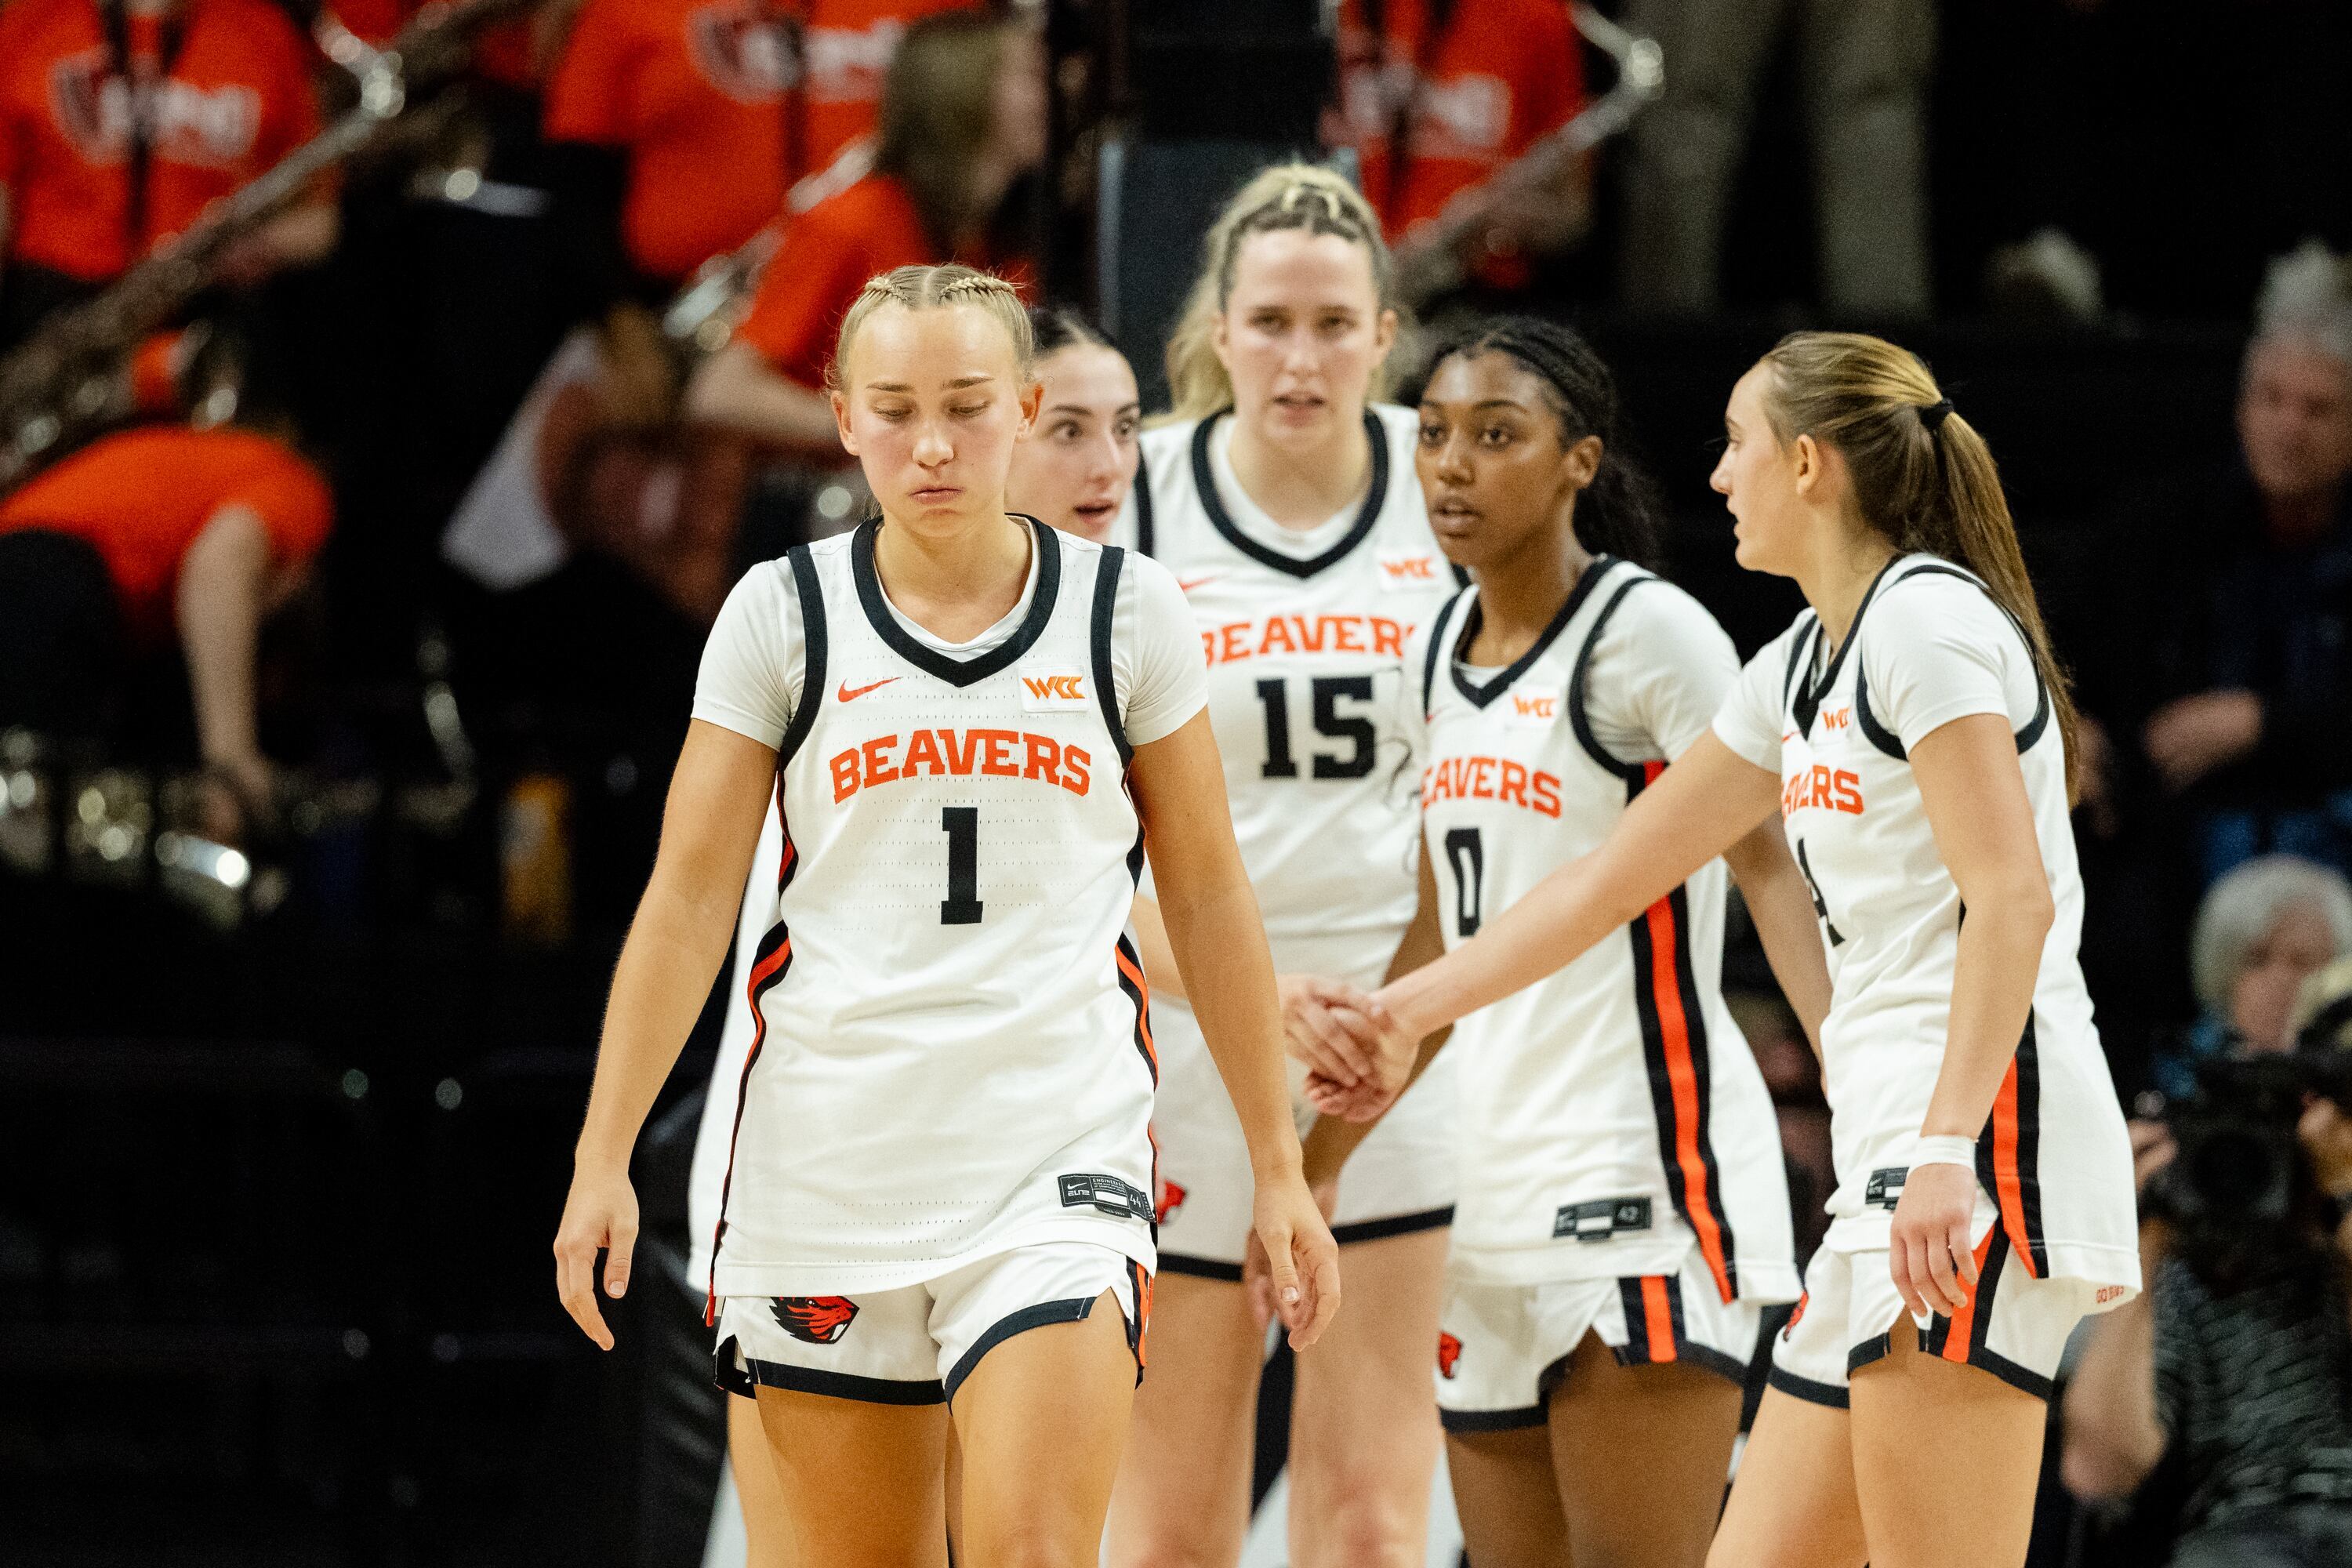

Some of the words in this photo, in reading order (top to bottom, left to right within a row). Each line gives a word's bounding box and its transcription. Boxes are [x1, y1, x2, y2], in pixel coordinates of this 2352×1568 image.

[1381, 556, 1435, 579] WCC
[1201, 615, 1416, 669] BEAVER
[1022, 676, 1085, 699] WCC
[1255, 675, 1375, 779] 15
[829, 728, 1091, 805] BEAVERS
[1421, 756, 1562, 818] EAVERS
[940, 807, 984, 925] 1
[1444, 827, 1483, 936] 0
[1130, 1193, 1142, 1209] 44
